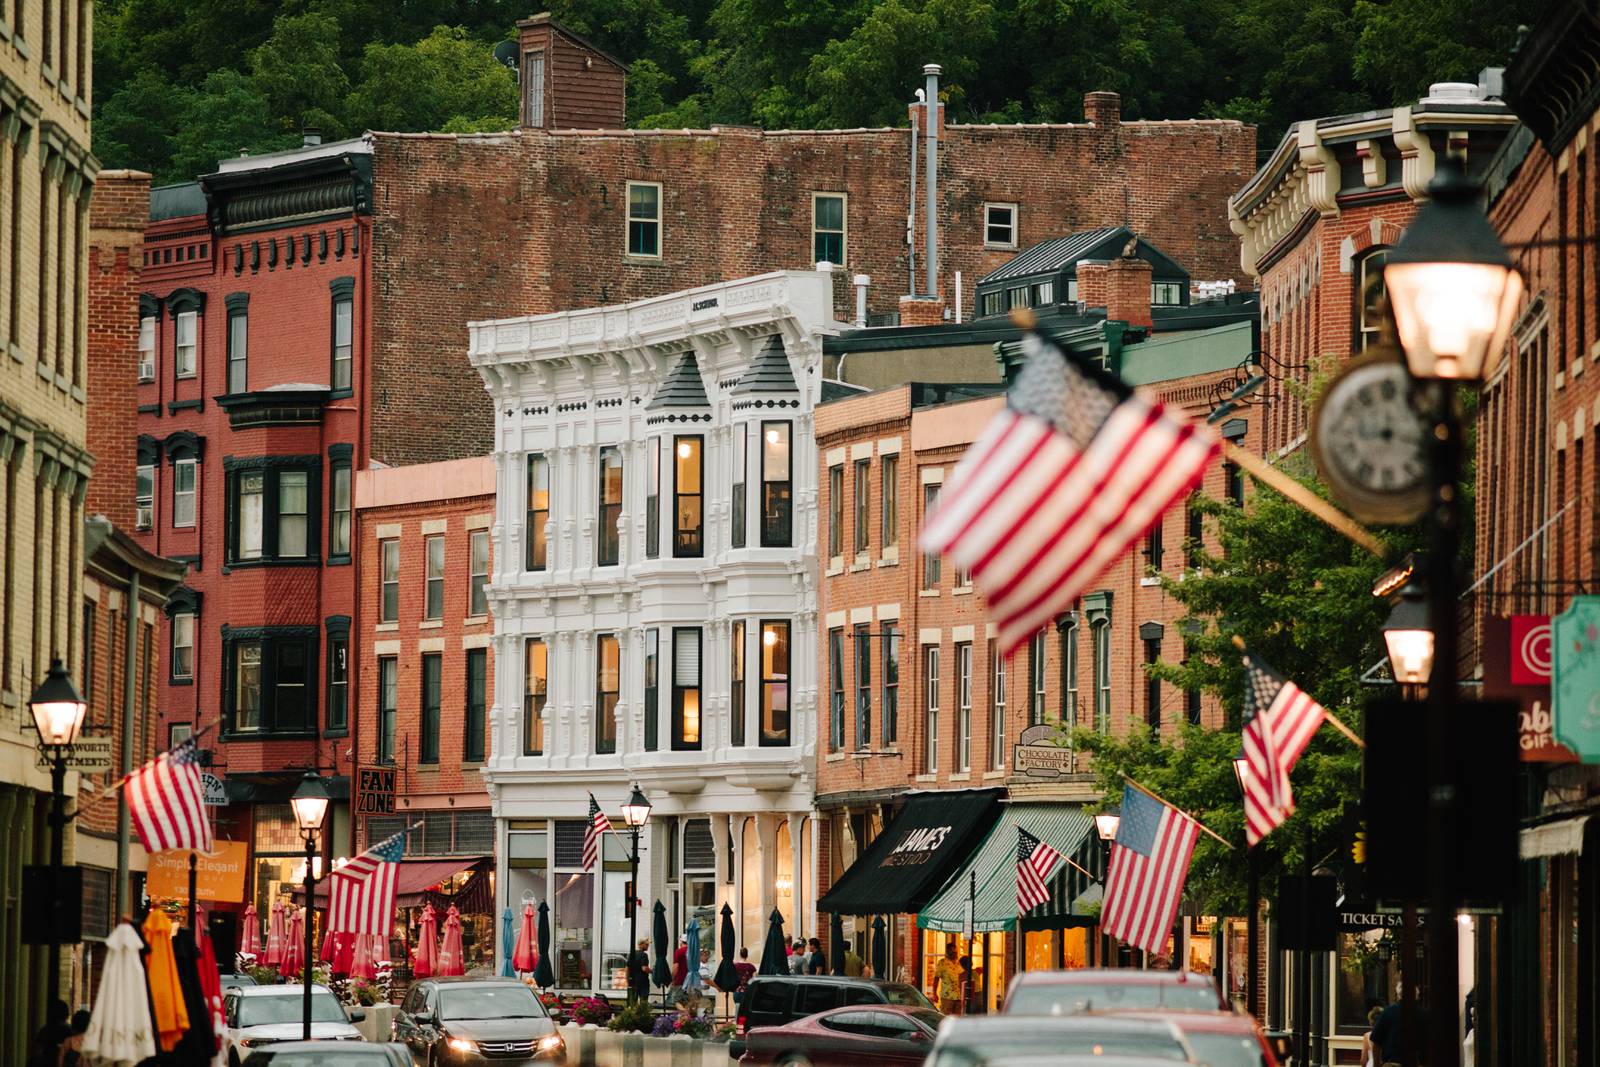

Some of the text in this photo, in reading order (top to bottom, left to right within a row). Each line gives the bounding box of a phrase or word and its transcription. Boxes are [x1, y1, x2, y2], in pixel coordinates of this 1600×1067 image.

[37, 758, 111, 767] APTMENTS
[1018, 750, 1069, 762] CHOCOLATE
[1025, 760, 1062, 769] FACTORY
[360, 771, 394, 791] FAN
[358, 792, 394, 813] ZONE
[156, 855, 239, 874] Simpl Elegant
[1341, 912, 1425, 928] TICKET SAS
